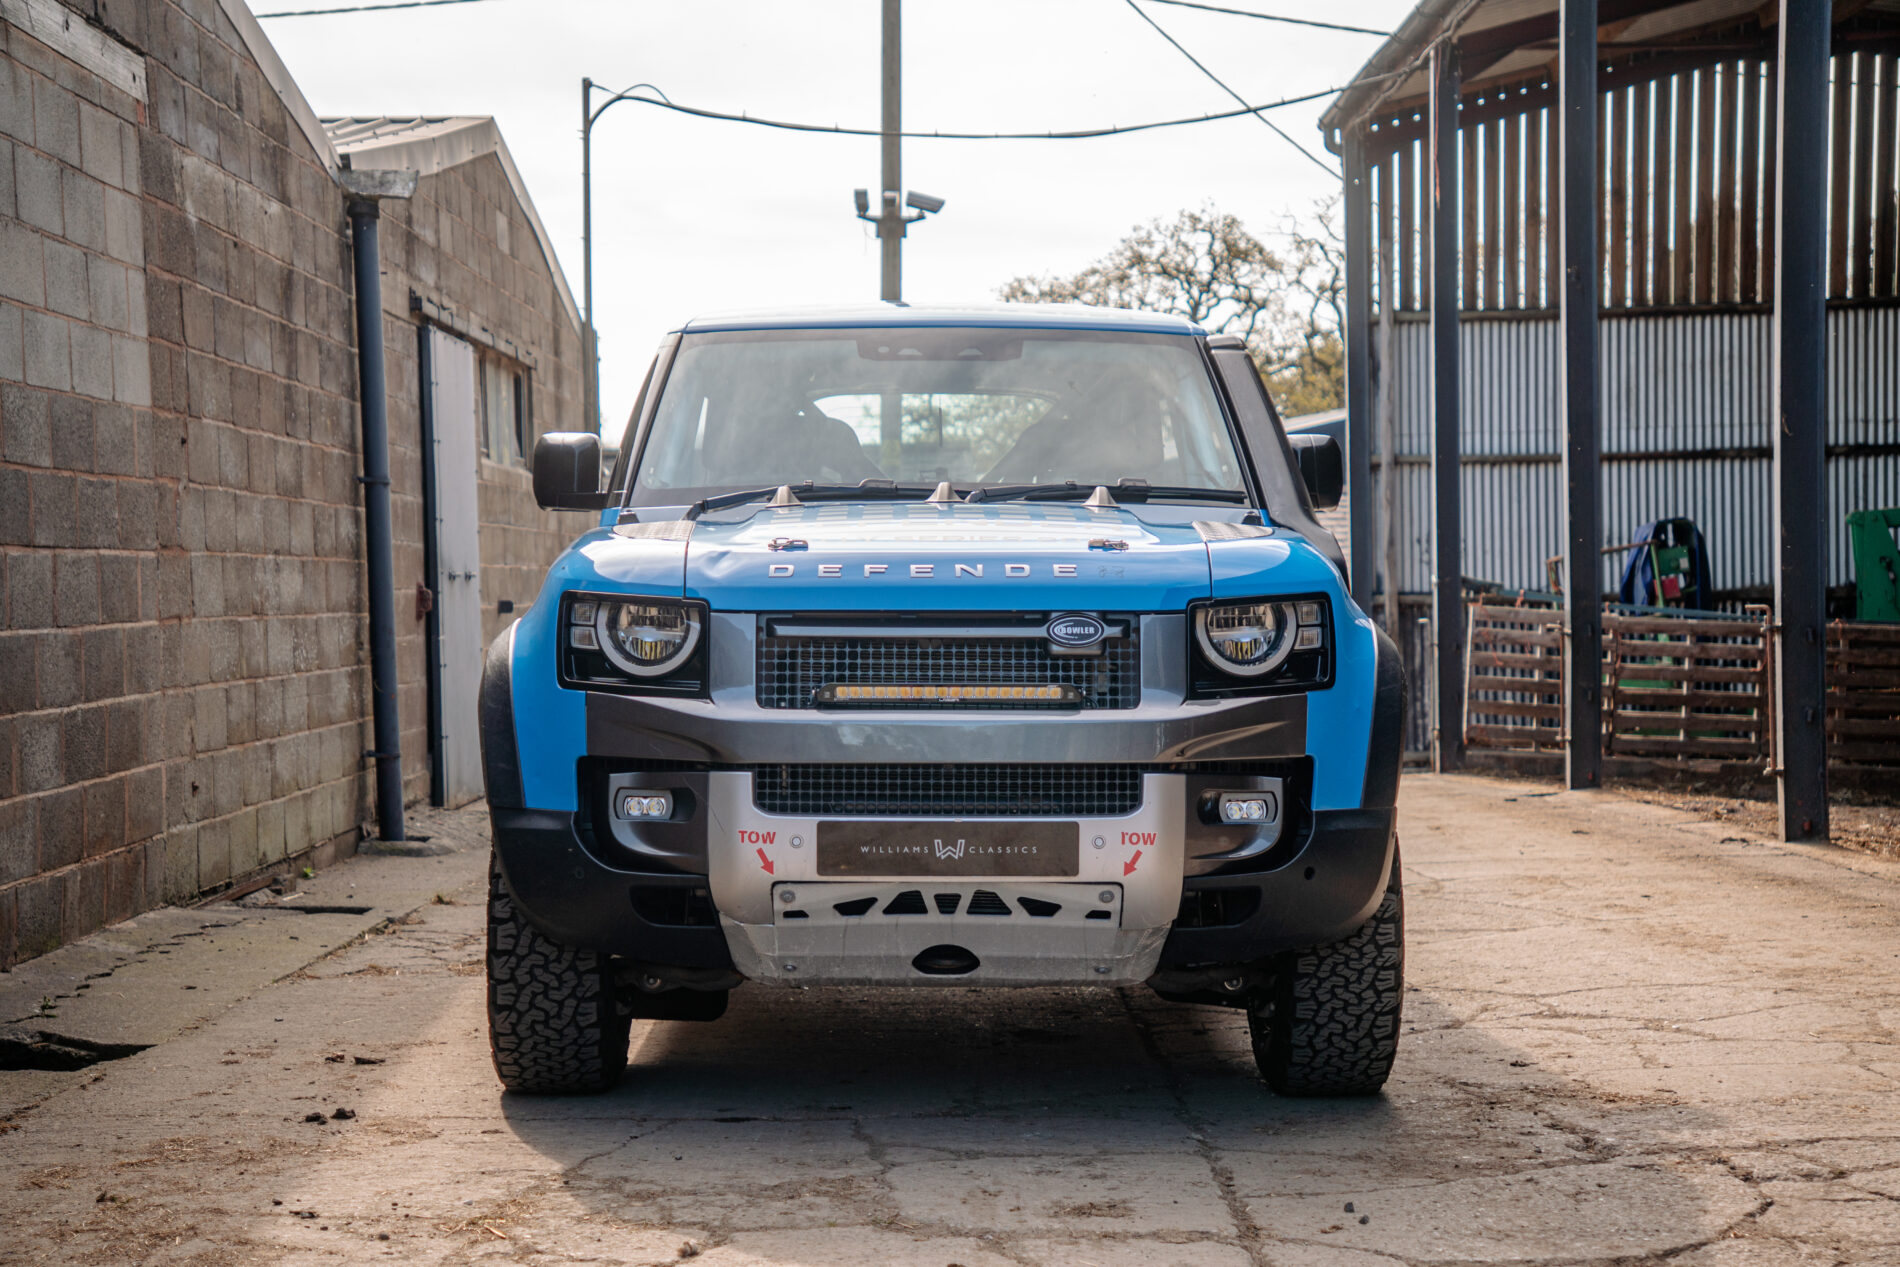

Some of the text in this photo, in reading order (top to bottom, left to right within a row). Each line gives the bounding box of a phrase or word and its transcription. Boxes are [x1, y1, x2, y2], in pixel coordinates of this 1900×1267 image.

[1060, 626, 1095, 634] BOWLER
[738, 830, 777, 845] TOW
[860, 845, 929, 854] WILLIAMS
[969, 845, 1038, 854] CLASSICS
